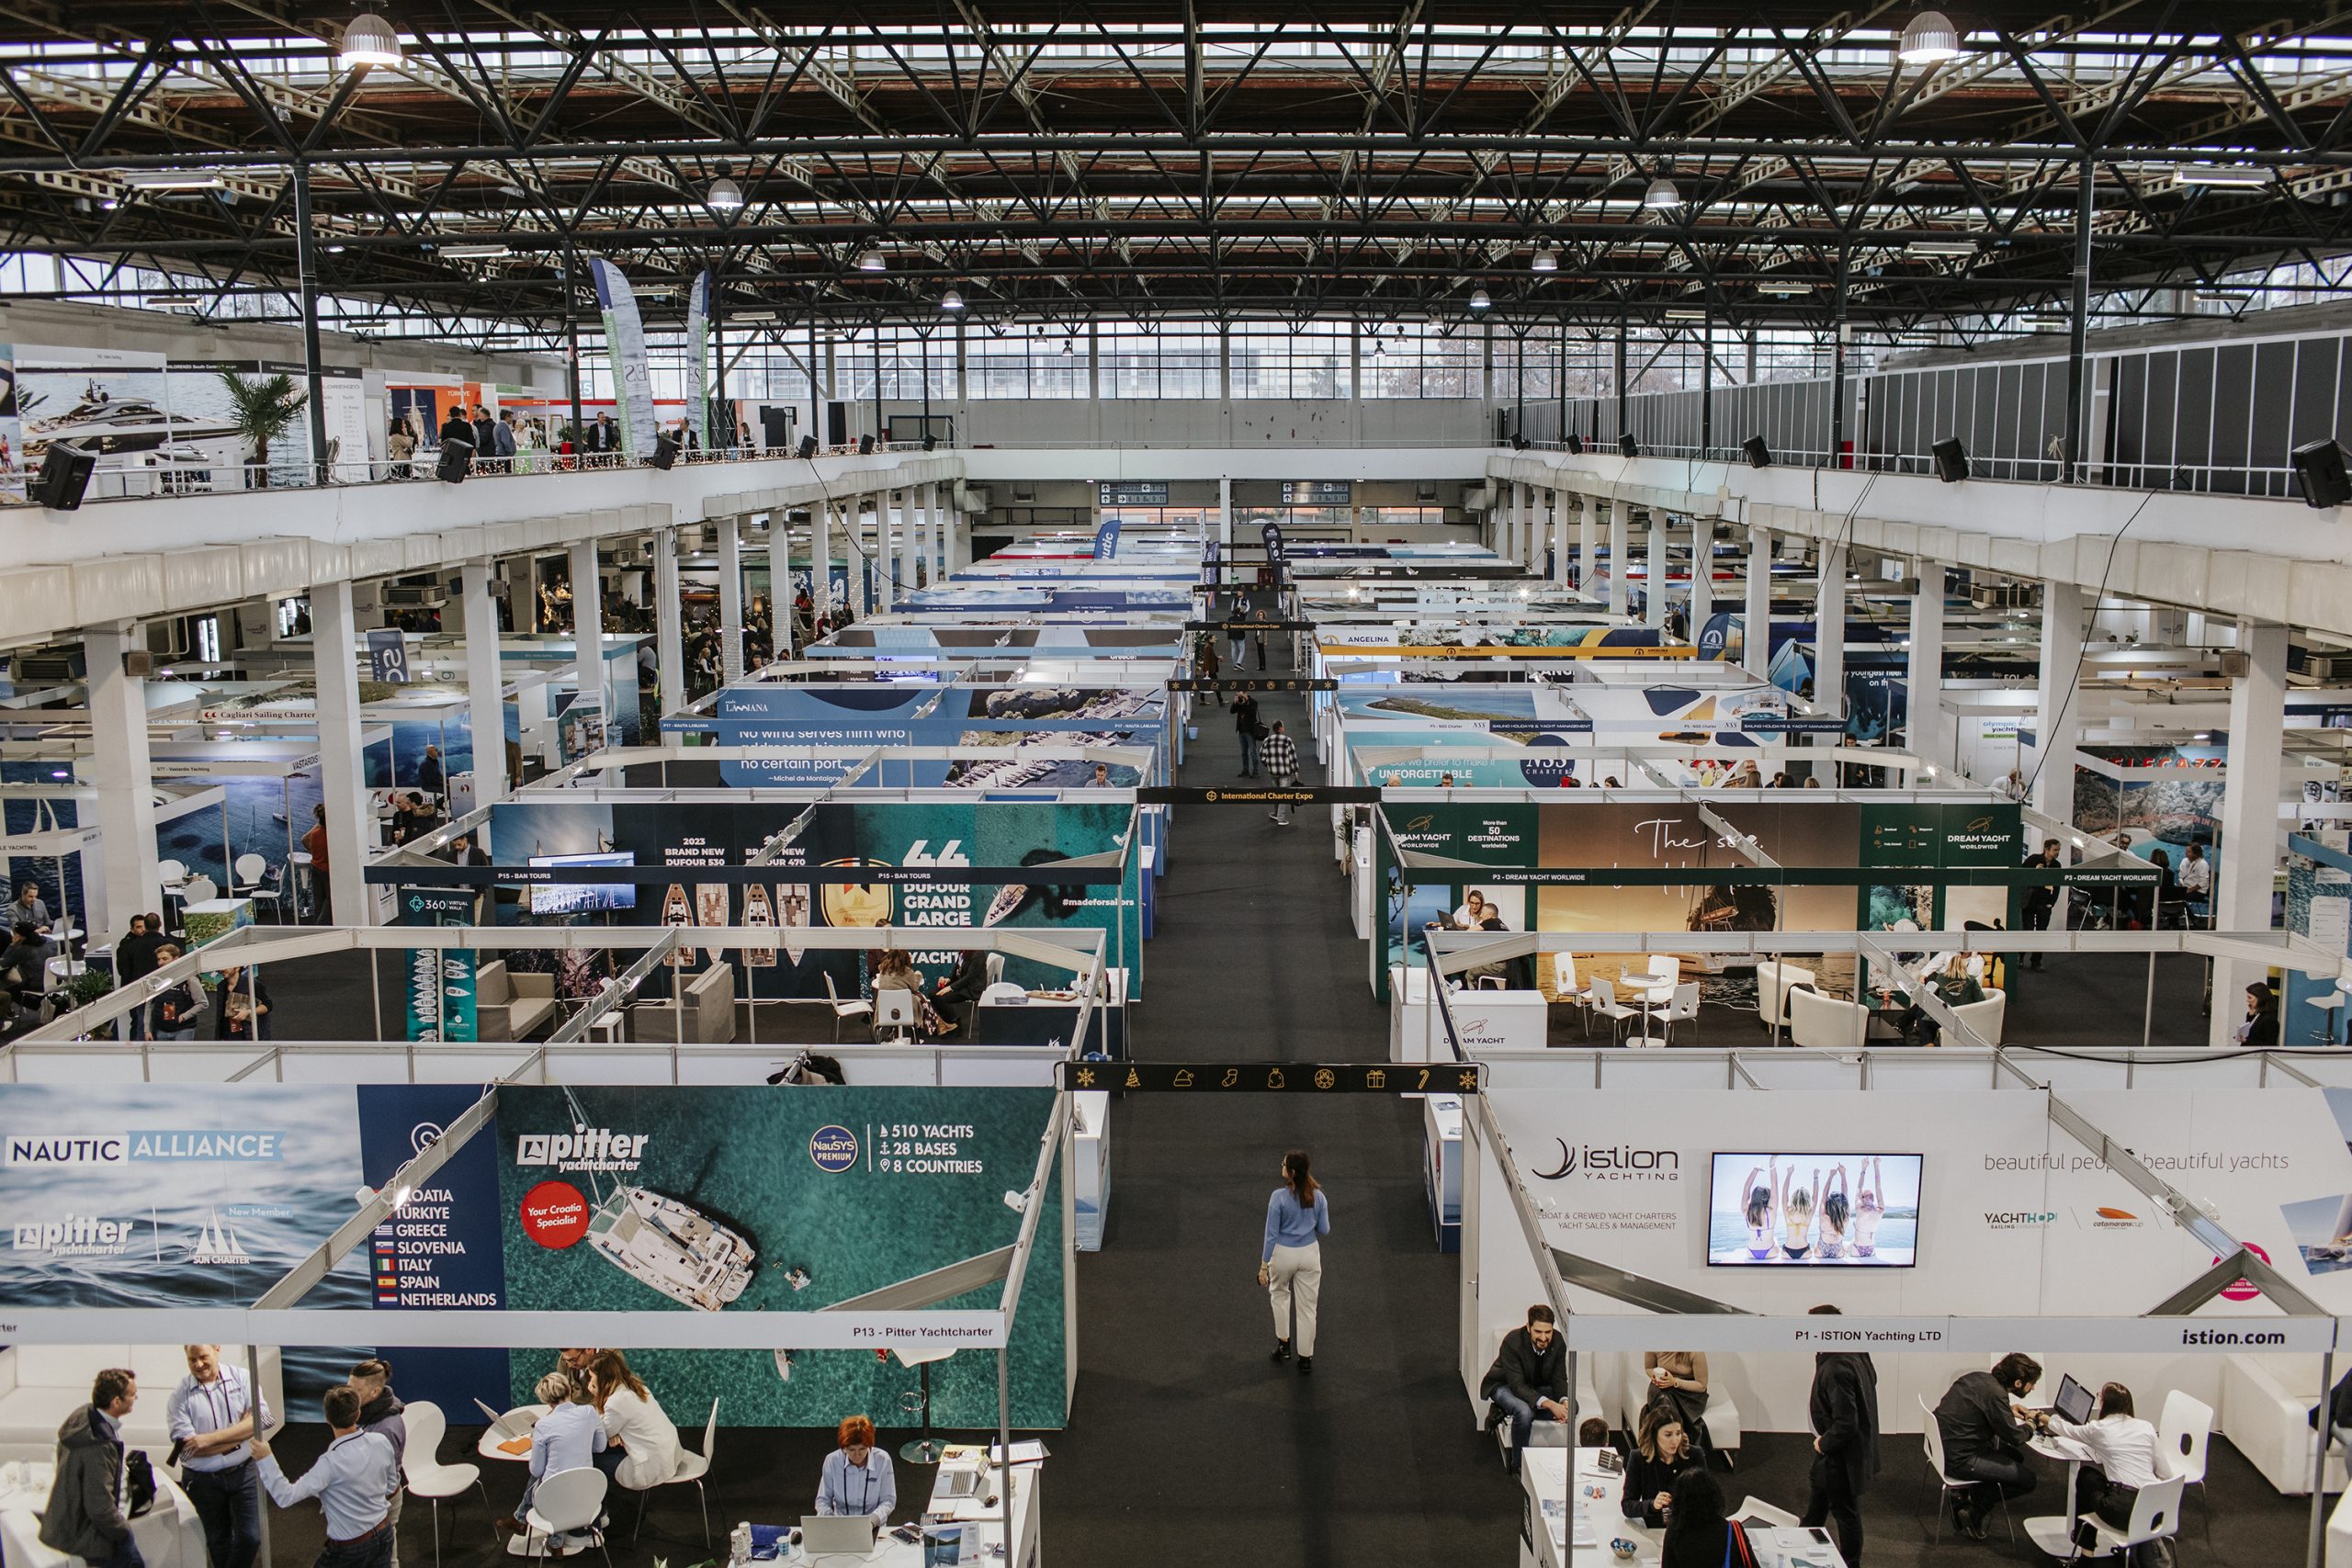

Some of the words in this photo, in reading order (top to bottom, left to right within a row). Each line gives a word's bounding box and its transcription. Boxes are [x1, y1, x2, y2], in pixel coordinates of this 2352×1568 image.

[220, 711, 253, 719] Cagliari
[254, 711, 282, 719] Sailing
[292, 754, 319, 771] VASTARDIS
[741, 761, 759, 769] no
[762, 760, 810, 769] certain
[814, 760, 845, 772] port.
[1424, 759, 1450, 768] prefer
[1221, 792, 1266, 800] International
[1267, 792, 1289, 800] Charter
[1290, 792, 1314, 801] Expo
[1634, 818, 1707, 858] The
[902, 840, 970, 867] 44
[903, 884, 970, 893] DUFOUR
[425, 899, 446, 910] 360
[903, 896, 971, 908] GRAND
[1062, 897, 1135, 907] #madeforsaiors
[904, 911, 971, 926] LARGE
[891, 1124, 918, 1138] 510
[922, 1124, 974, 1138] YACHTS
[133, 1134, 275, 1158] ALLIANCE
[550, 1123, 649, 1162] pitter
[813, 1140, 855, 1152] NauSYS
[13, 1139, 121, 1162] NAUTIC
[893, 1143, 910, 1156] 28
[914, 1143, 956, 1156] BASES
[817, 1152, 852, 1161] PREMIUM
[1583, 1145, 1679, 1169] istion
[1984, 1153, 2065, 1170] beautiful
[2143, 1152, 2223, 1170] beautiful
[2229, 1153, 2290, 1173] yachts
[559, 1157, 641, 1174] yachtcharter
[893, 1160, 902, 1173] 8
[906, 1160, 983, 1173] COUNTRIES
[229, 1207, 245, 1217] New
[247, 1207, 290, 1217] Member
[396, 1203, 450, 1220] TÜRKIYE
[527, 1207, 548, 1218] Your
[549, 1201, 582, 1215] Croatia
[536, 1213, 578, 1229] Specialist
[42, 1213, 133, 1250] pitter
[396, 1224, 447, 1237] GREECE
[51, 1241, 126, 1257] yachtcharter
[398, 1241, 466, 1255] SLOVENIA
[193, 1255, 210, 1264] SUN
[212, 1255, 251, 1264] CHARTER
[398, 1258, 433, 1271] ITALY
[400, 1276, 440, 1289] SPAIN
[401, 1293, 497, 1306] NETHERLANDS
[854, 1326, 875, 1337] P13
[886, 1326, 917, 1337] Pitter
[920, 1326, 993, 1337] Yachtcharter
[1795, 1331, 1811, 1341] P1
[1820, 1330, 1861, 1342] ISTION
[1864, 1330, 1916, 1344] Yachting
[1918, 1330, 1941, 1341] LTD
[2182, 1329, 2286, 1345] istion.com
